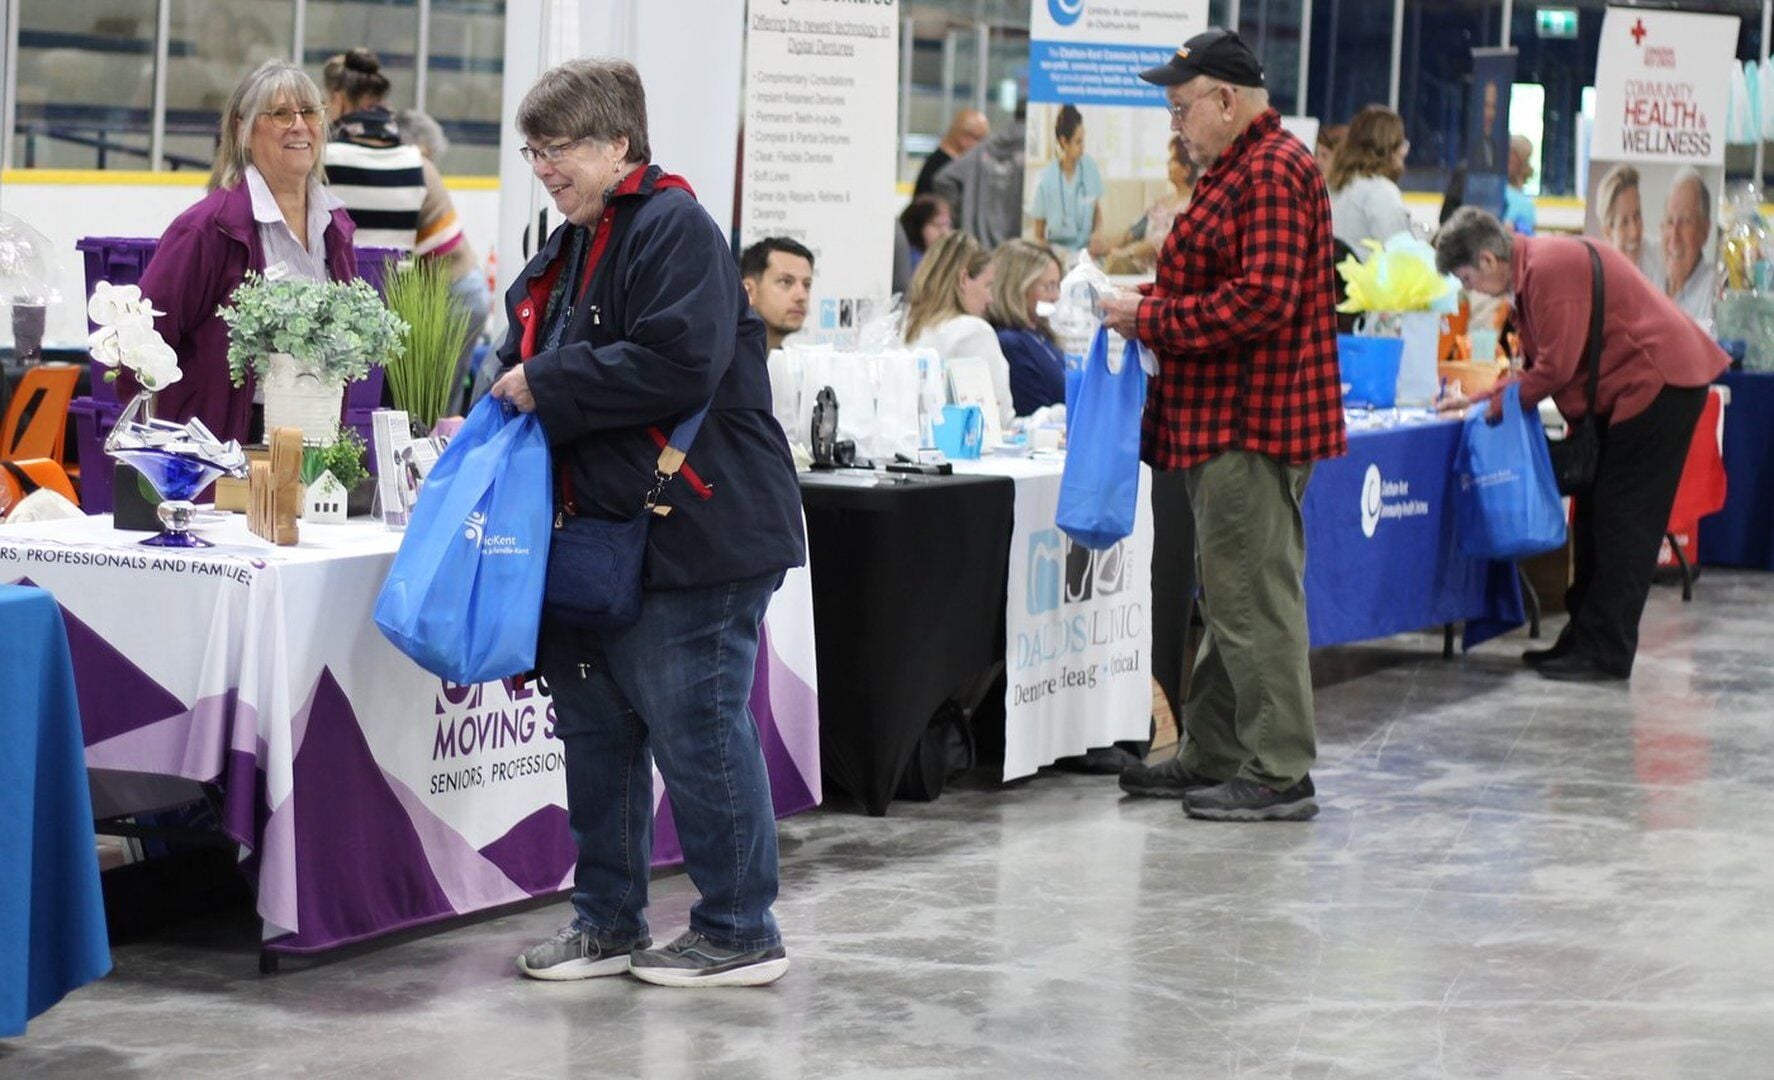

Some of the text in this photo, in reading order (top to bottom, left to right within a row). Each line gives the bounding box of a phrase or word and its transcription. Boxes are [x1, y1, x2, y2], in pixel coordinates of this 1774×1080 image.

[789, 16, 802, 31] the
[804, 20, 833, 33] newest
[788, 37, 854, 56] Digital Dentures
[1625, 79, 1695, 98] COMMUNITY
[1624, 99, 1698, 129] HEALTH
[1622, 128, 1712, 157] WELLNESS
[27, 548, 148, 569] PROFESSIONALS
[151, 558, 186, 573] AND
[191, 560, 253, 587] FAMILIES
[432, 705, 536, 761] MOVING
[430, 766, 486, 795] SENIORS,
